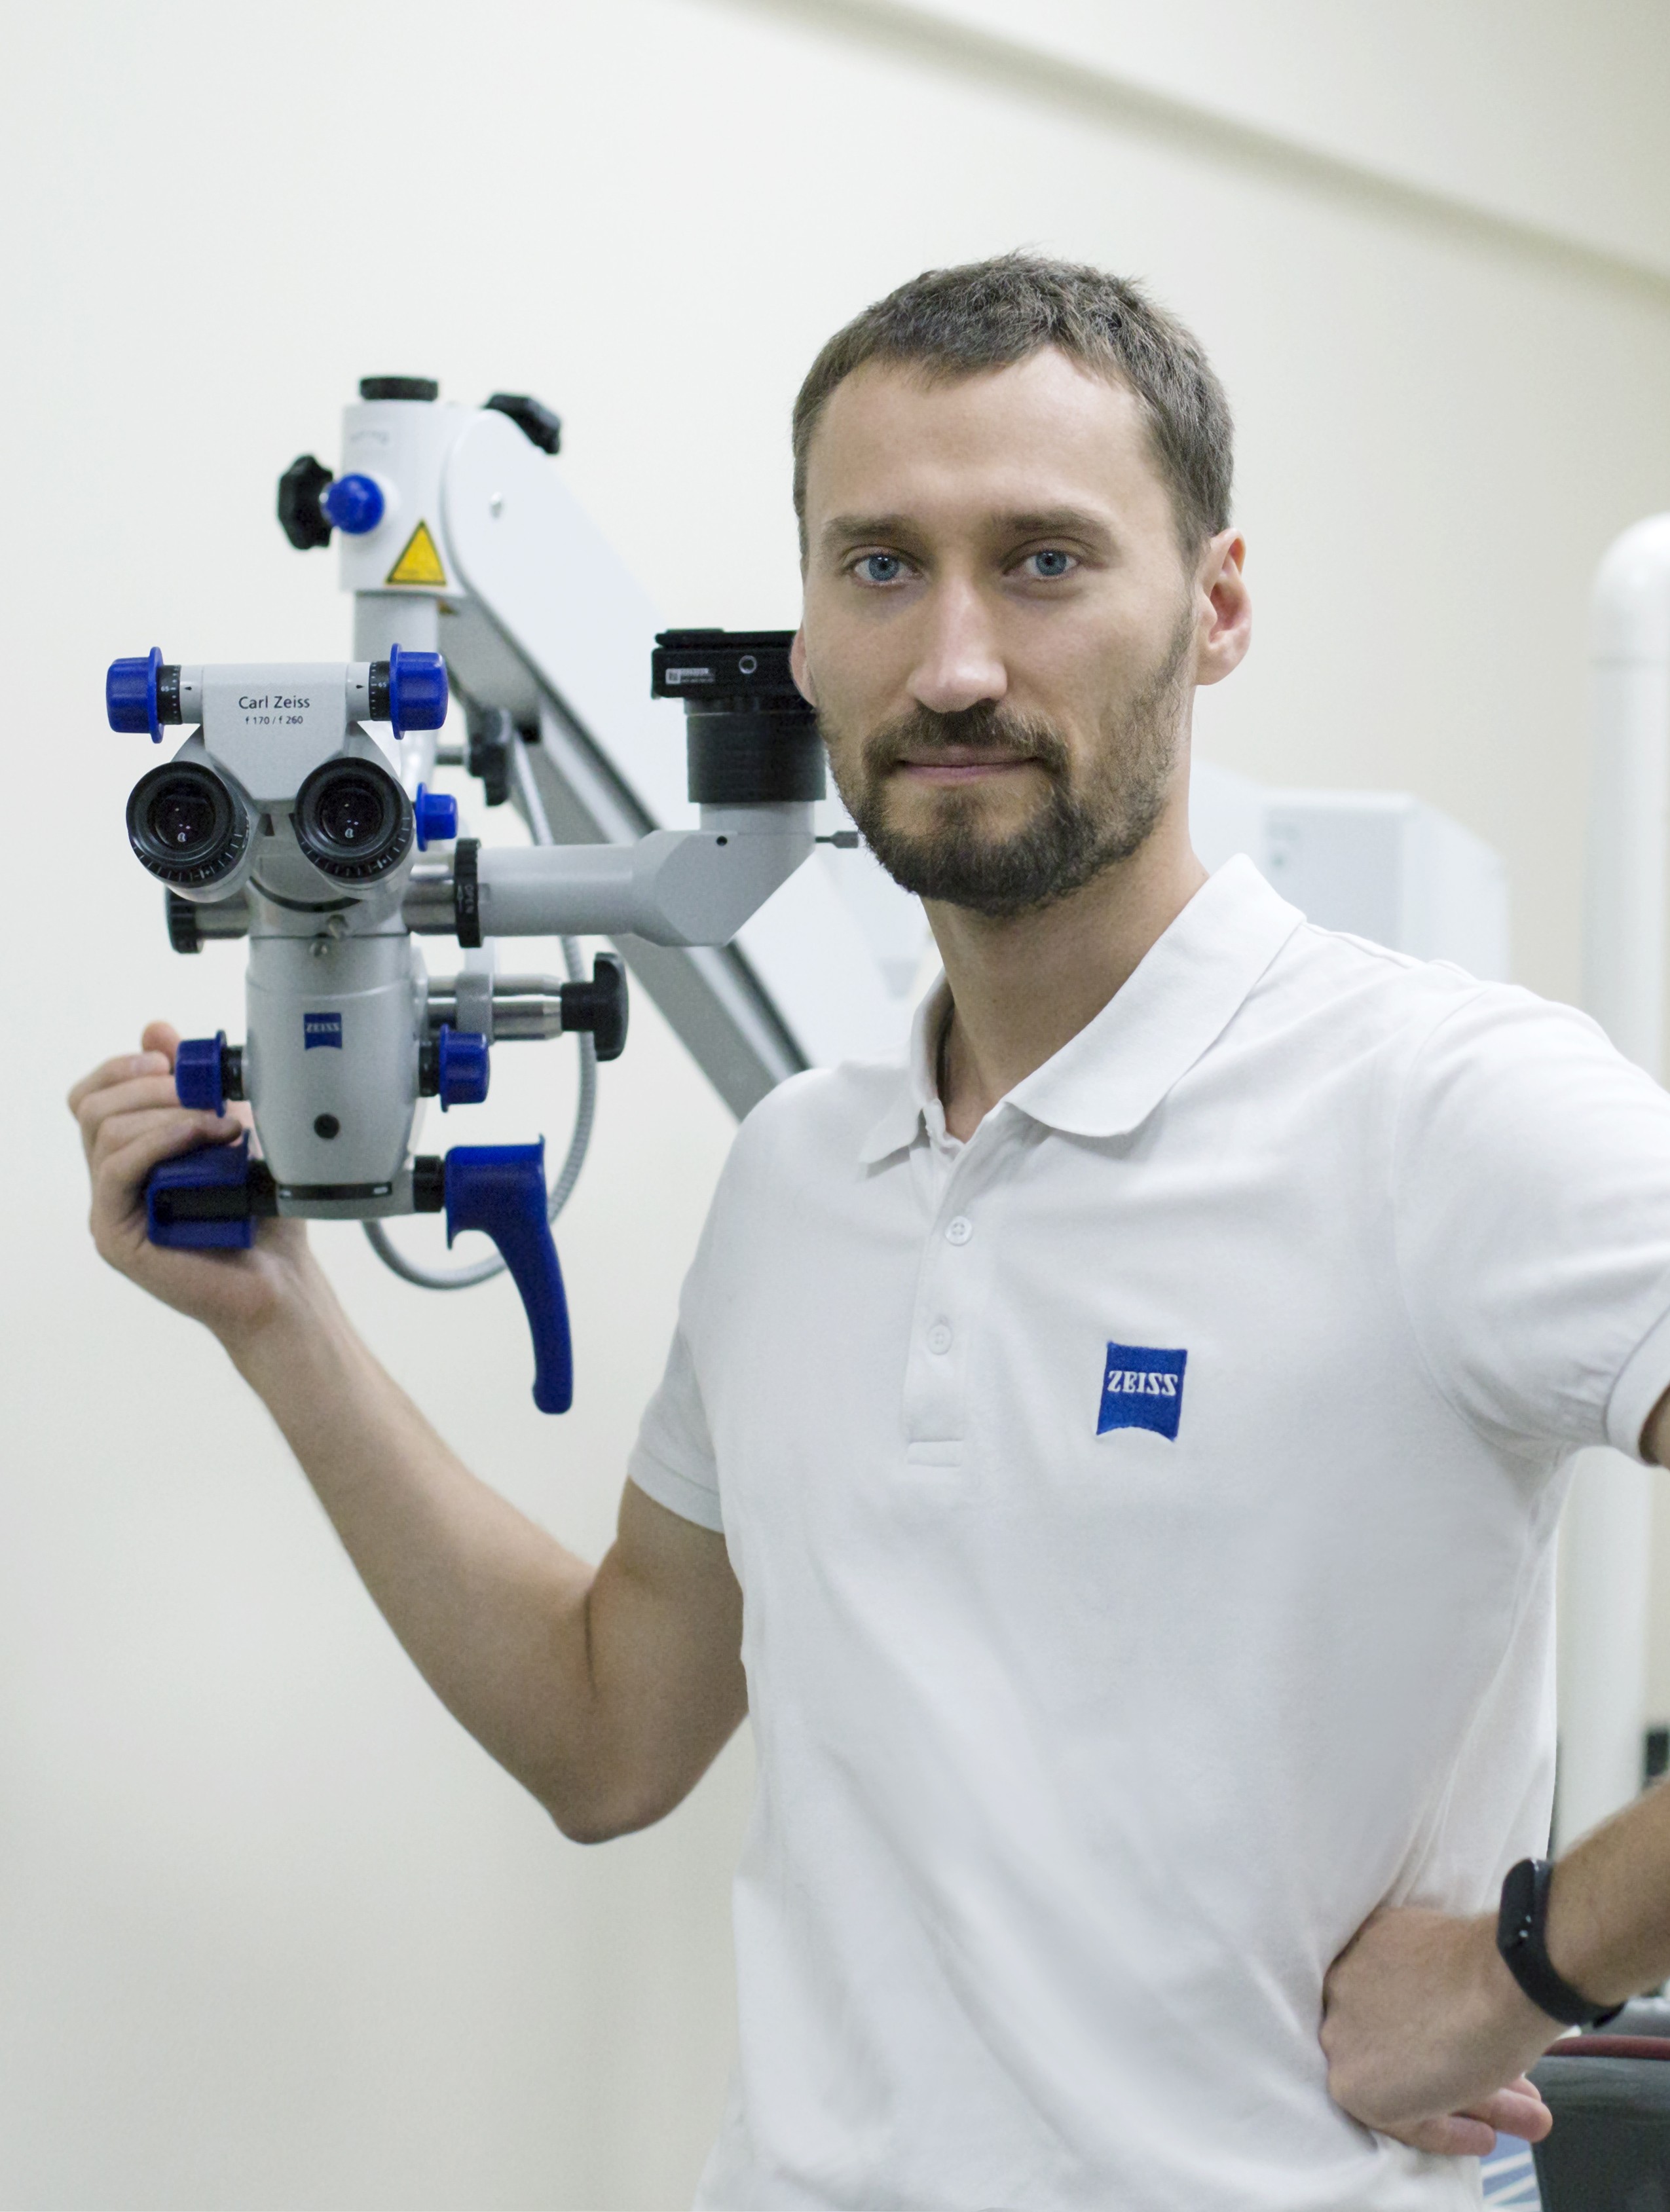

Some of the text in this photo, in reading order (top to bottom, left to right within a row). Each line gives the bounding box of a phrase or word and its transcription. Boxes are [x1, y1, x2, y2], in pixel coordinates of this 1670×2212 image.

[238, 695, 310, 709] Carl Zeiss
[253, 716, 270, 725] 170
[286, 716, 303, 724] 260
[306, 1023, 340, 1033] ZEISS
[1107, 1370, 1178, 1396] ZEISS
